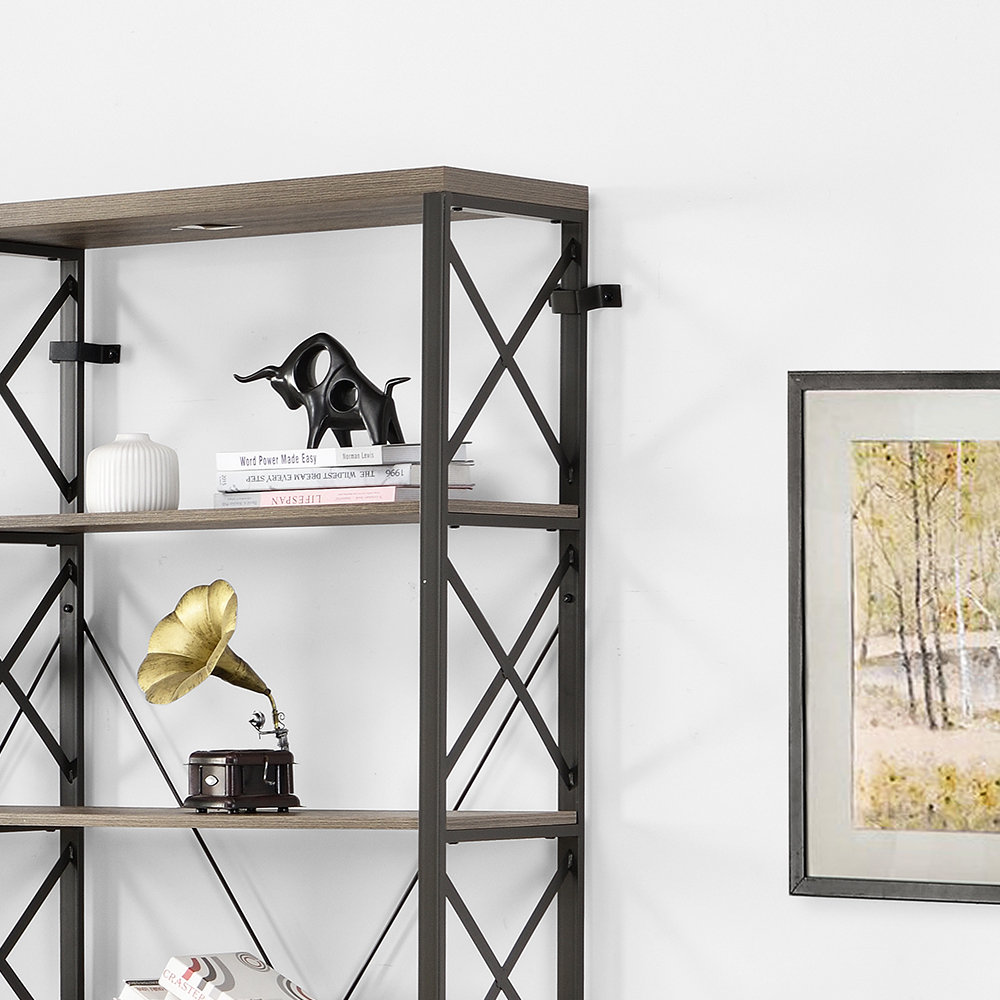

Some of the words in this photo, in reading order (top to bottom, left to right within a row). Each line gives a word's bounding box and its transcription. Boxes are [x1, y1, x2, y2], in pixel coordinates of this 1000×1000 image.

[240, 456, 257, 466] Word
[259, 455, 279, 466] Power
[281, 454, 299, 464] Made
[301, 453, 317, 464] Easy
[342, 452, 360, 460] Norman
[361, 451, 375, 459] Lewis
[266, 473, 292, 482] EVERY
[293, 472, 321, 480] DREAM
[322, 471, 356, 480] WILDEST
[360, 470, 375, 478] THE
[245, 475, 266, 483] STEP
[271, 495, 322, 505] LIFESPAN
